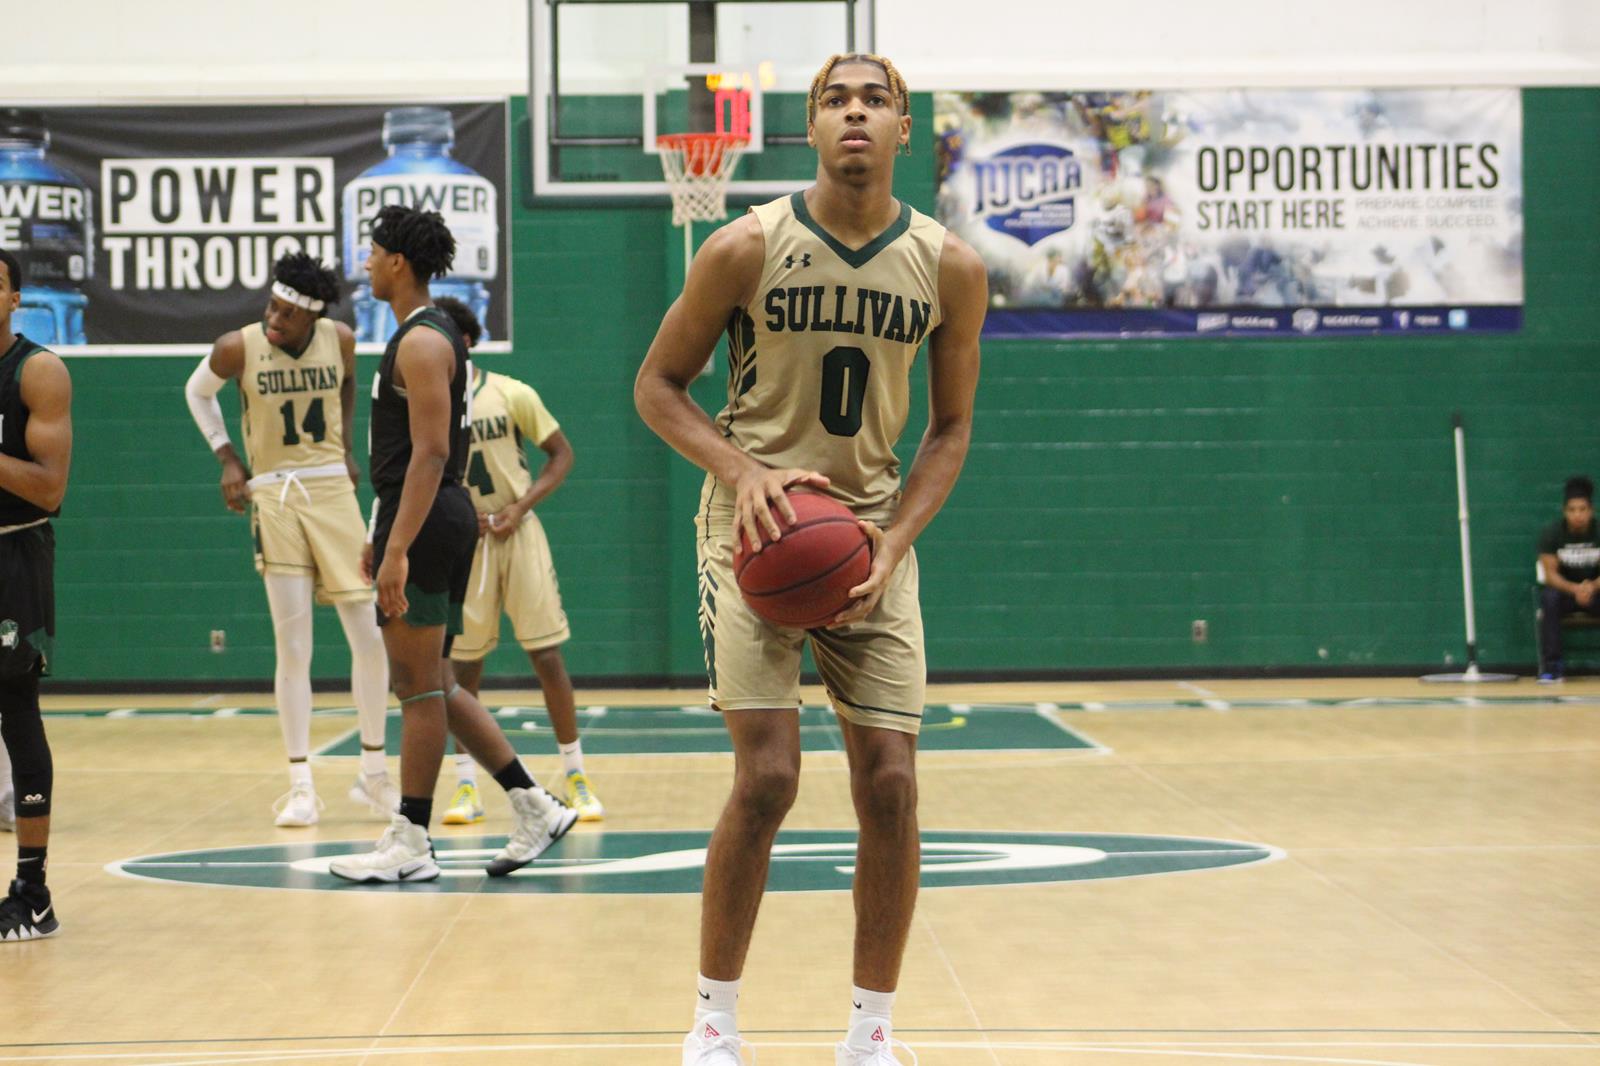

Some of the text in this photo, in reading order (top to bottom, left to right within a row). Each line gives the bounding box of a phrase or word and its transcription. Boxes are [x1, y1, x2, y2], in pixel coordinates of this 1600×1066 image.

[1198, 144, 1499, 192] OPPORTUNITIES
[110, 166, 325, 225] POWER
[357, 183, 488, 214] POWER
[1198, 199, 1345, 230] START HERE
[765, 286, 931, 344] SULLIVAN
[257, 365, 338, 395] SULLIVAN
[819, 346, 870, 437] 0
[279, 397, 326, 446] 14
